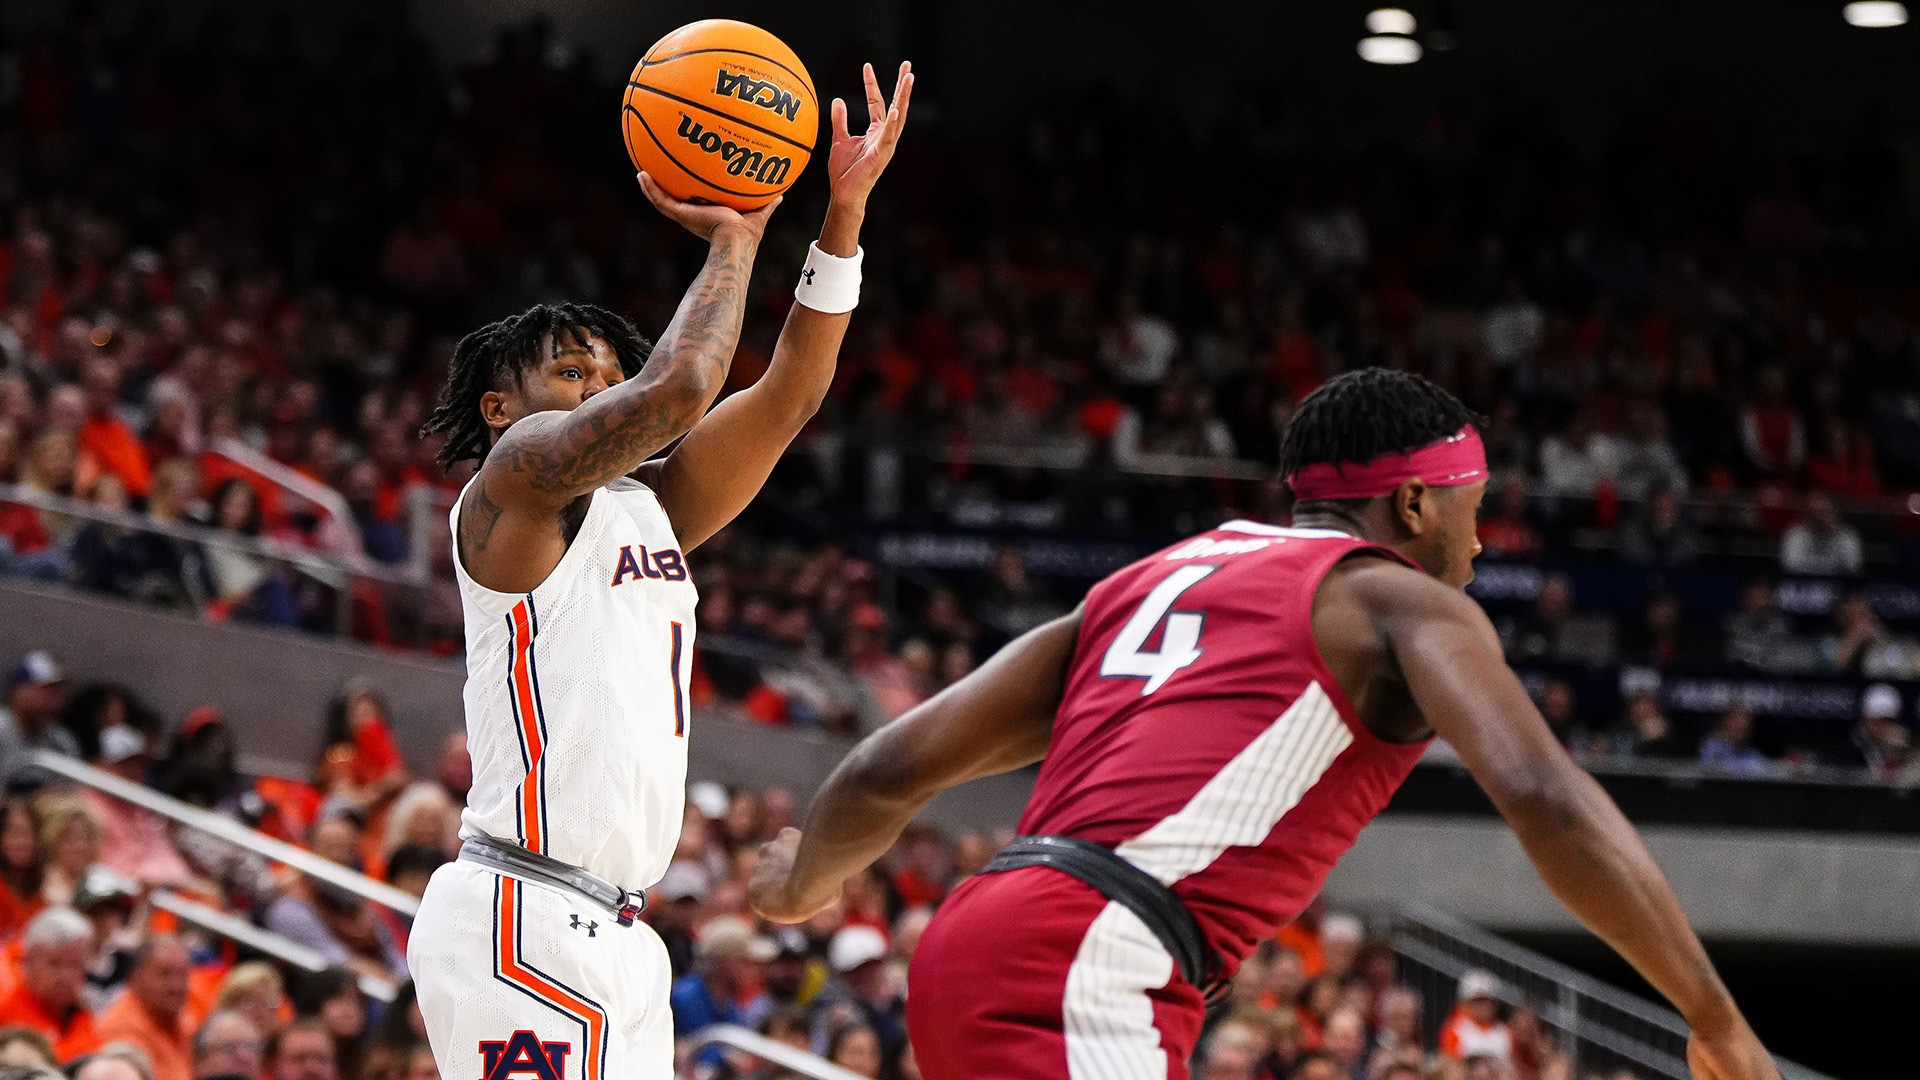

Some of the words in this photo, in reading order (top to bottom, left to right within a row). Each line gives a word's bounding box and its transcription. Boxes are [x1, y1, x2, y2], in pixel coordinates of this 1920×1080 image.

[715, 68, 802, 123] NCAA
[677, 114, 792, 185] Wilson
[611, 544, 692, 588] AUB
[1099, 563, 1225, 697] 4
[670, 620, 685, 738] 1
